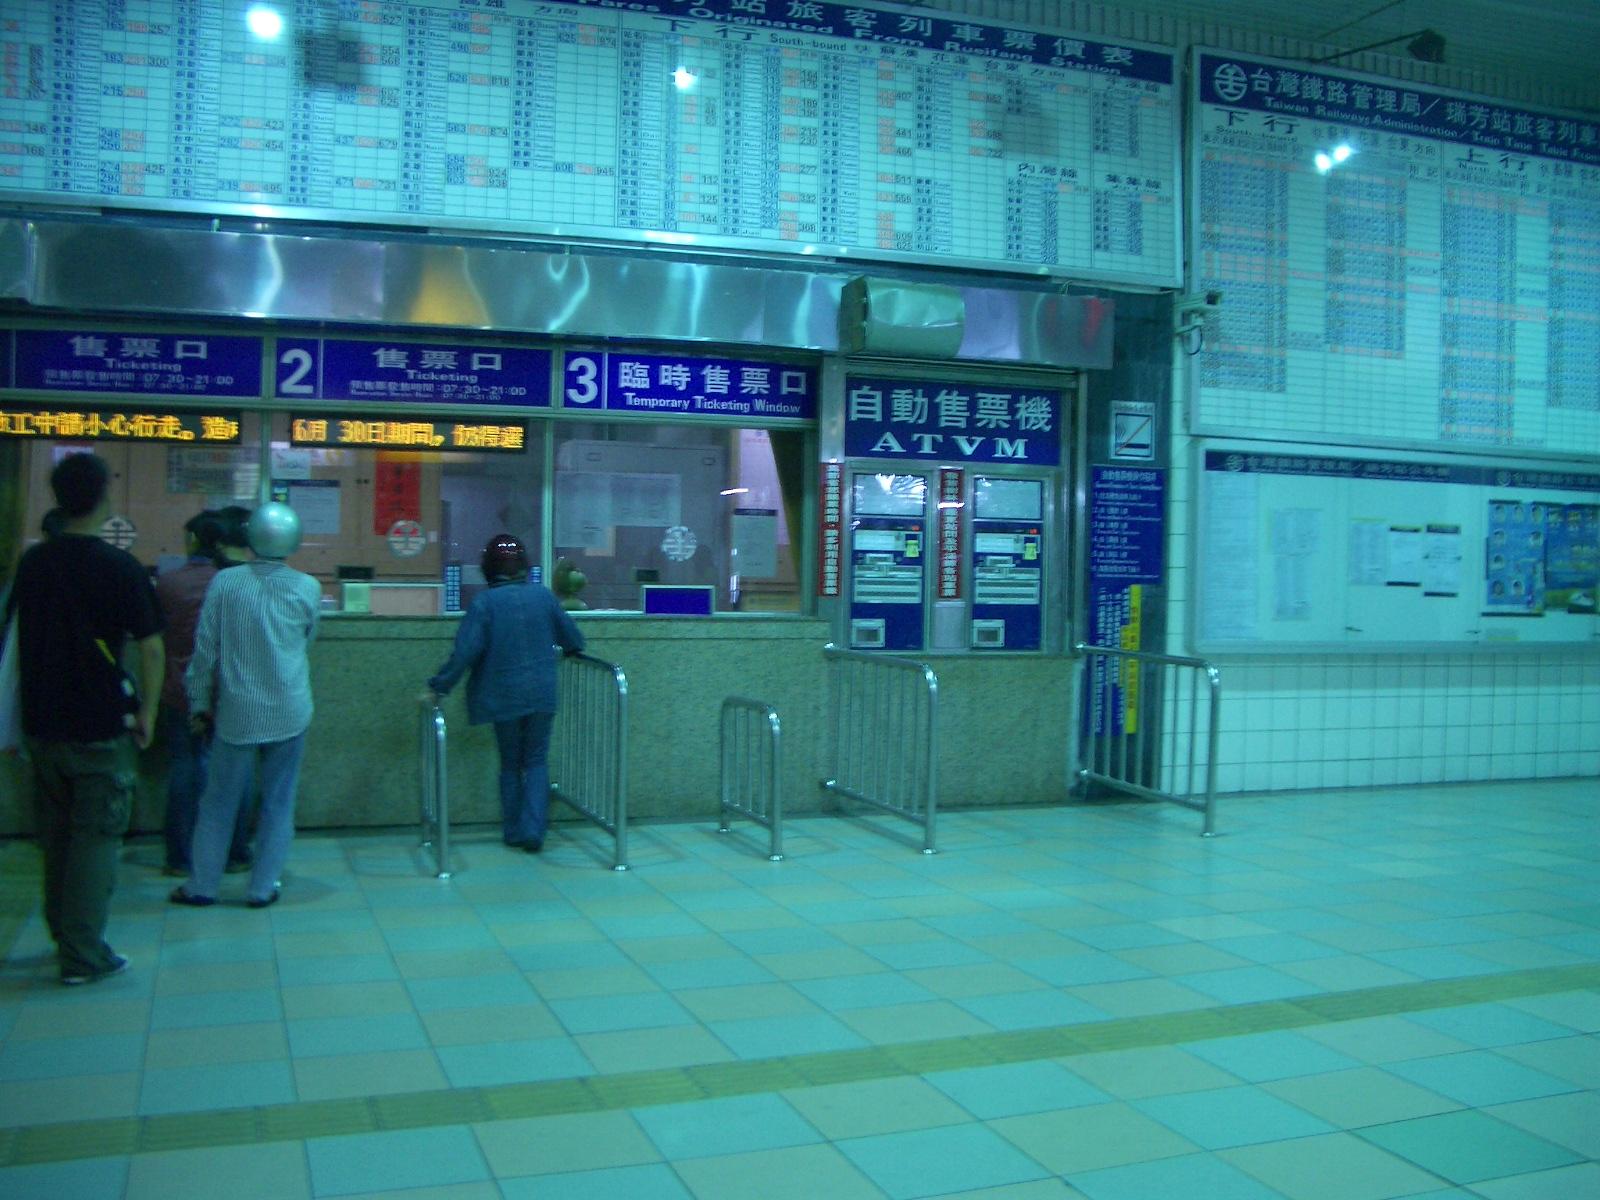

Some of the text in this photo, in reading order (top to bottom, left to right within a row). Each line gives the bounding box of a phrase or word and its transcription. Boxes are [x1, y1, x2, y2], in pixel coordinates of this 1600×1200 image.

[652, 16, 761, 42] 下行
[674, 0, 1133, 66] 站旅客列車票價表
[688, 7, 834, 34] Originated
[853, 28, 925, 47] From
[1050, 55, 1122, 75] Station
[770, 33, 847, 51] South-bound
[1265, 96, 1309, 113] Taiwan
[1213, 107, 1301, 134] 下行
[1455, 147, 1531, 172] 上行
[68, 335, 208, 360] 售票口
[373, 347, 502, 371] 售票口
[104, 358, 183, 372] Ticketing
[279, 347, 314, 395] 2
[406, 369, 478, 384] Ticketing
[566, 357, 599, 404] 3
[618, 361, 807, 395] 臨時售票口
[623, 393, 801, 413] Temporary Ticketing Window
[849, 385, 1052, 432] 自動售票機
